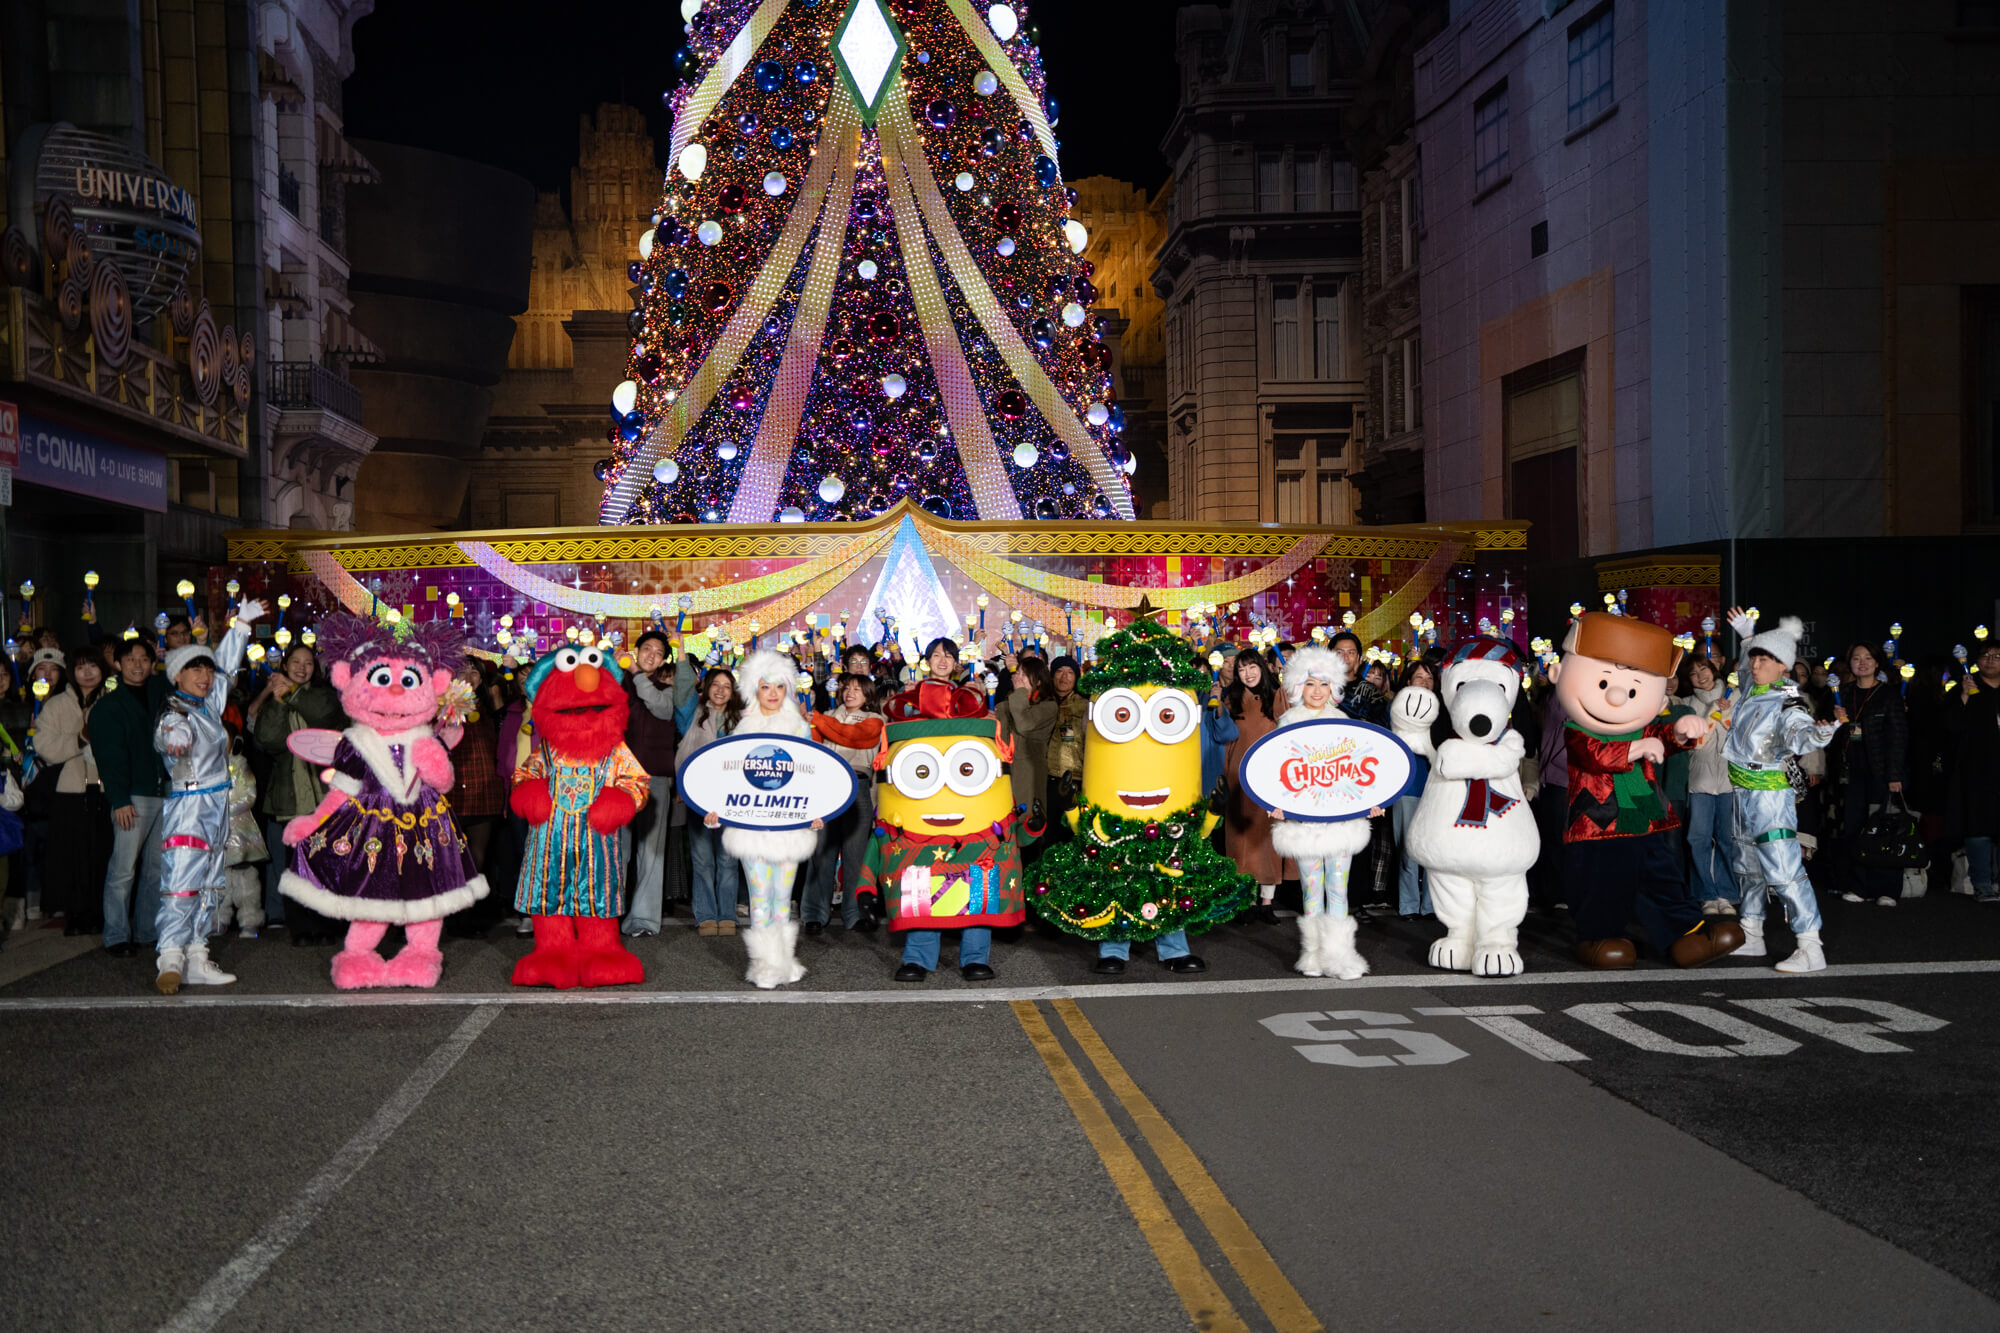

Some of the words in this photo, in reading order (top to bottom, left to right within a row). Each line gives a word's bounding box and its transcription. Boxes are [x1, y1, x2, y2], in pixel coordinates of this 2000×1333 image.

[37, 432, 96, 477] CONAN
[118, 461, 137, 481] LIVE
[138, 468, 163, 489] SHOW
[1279, 755, 1379, 793] CHRISTMAS
[1309, 751, 1323, 764] NO
[725, 794, 751, 807] NO
[753, 795, 809, 809] LIMIT!
[1256, 997, 1952, 1068] STOP
